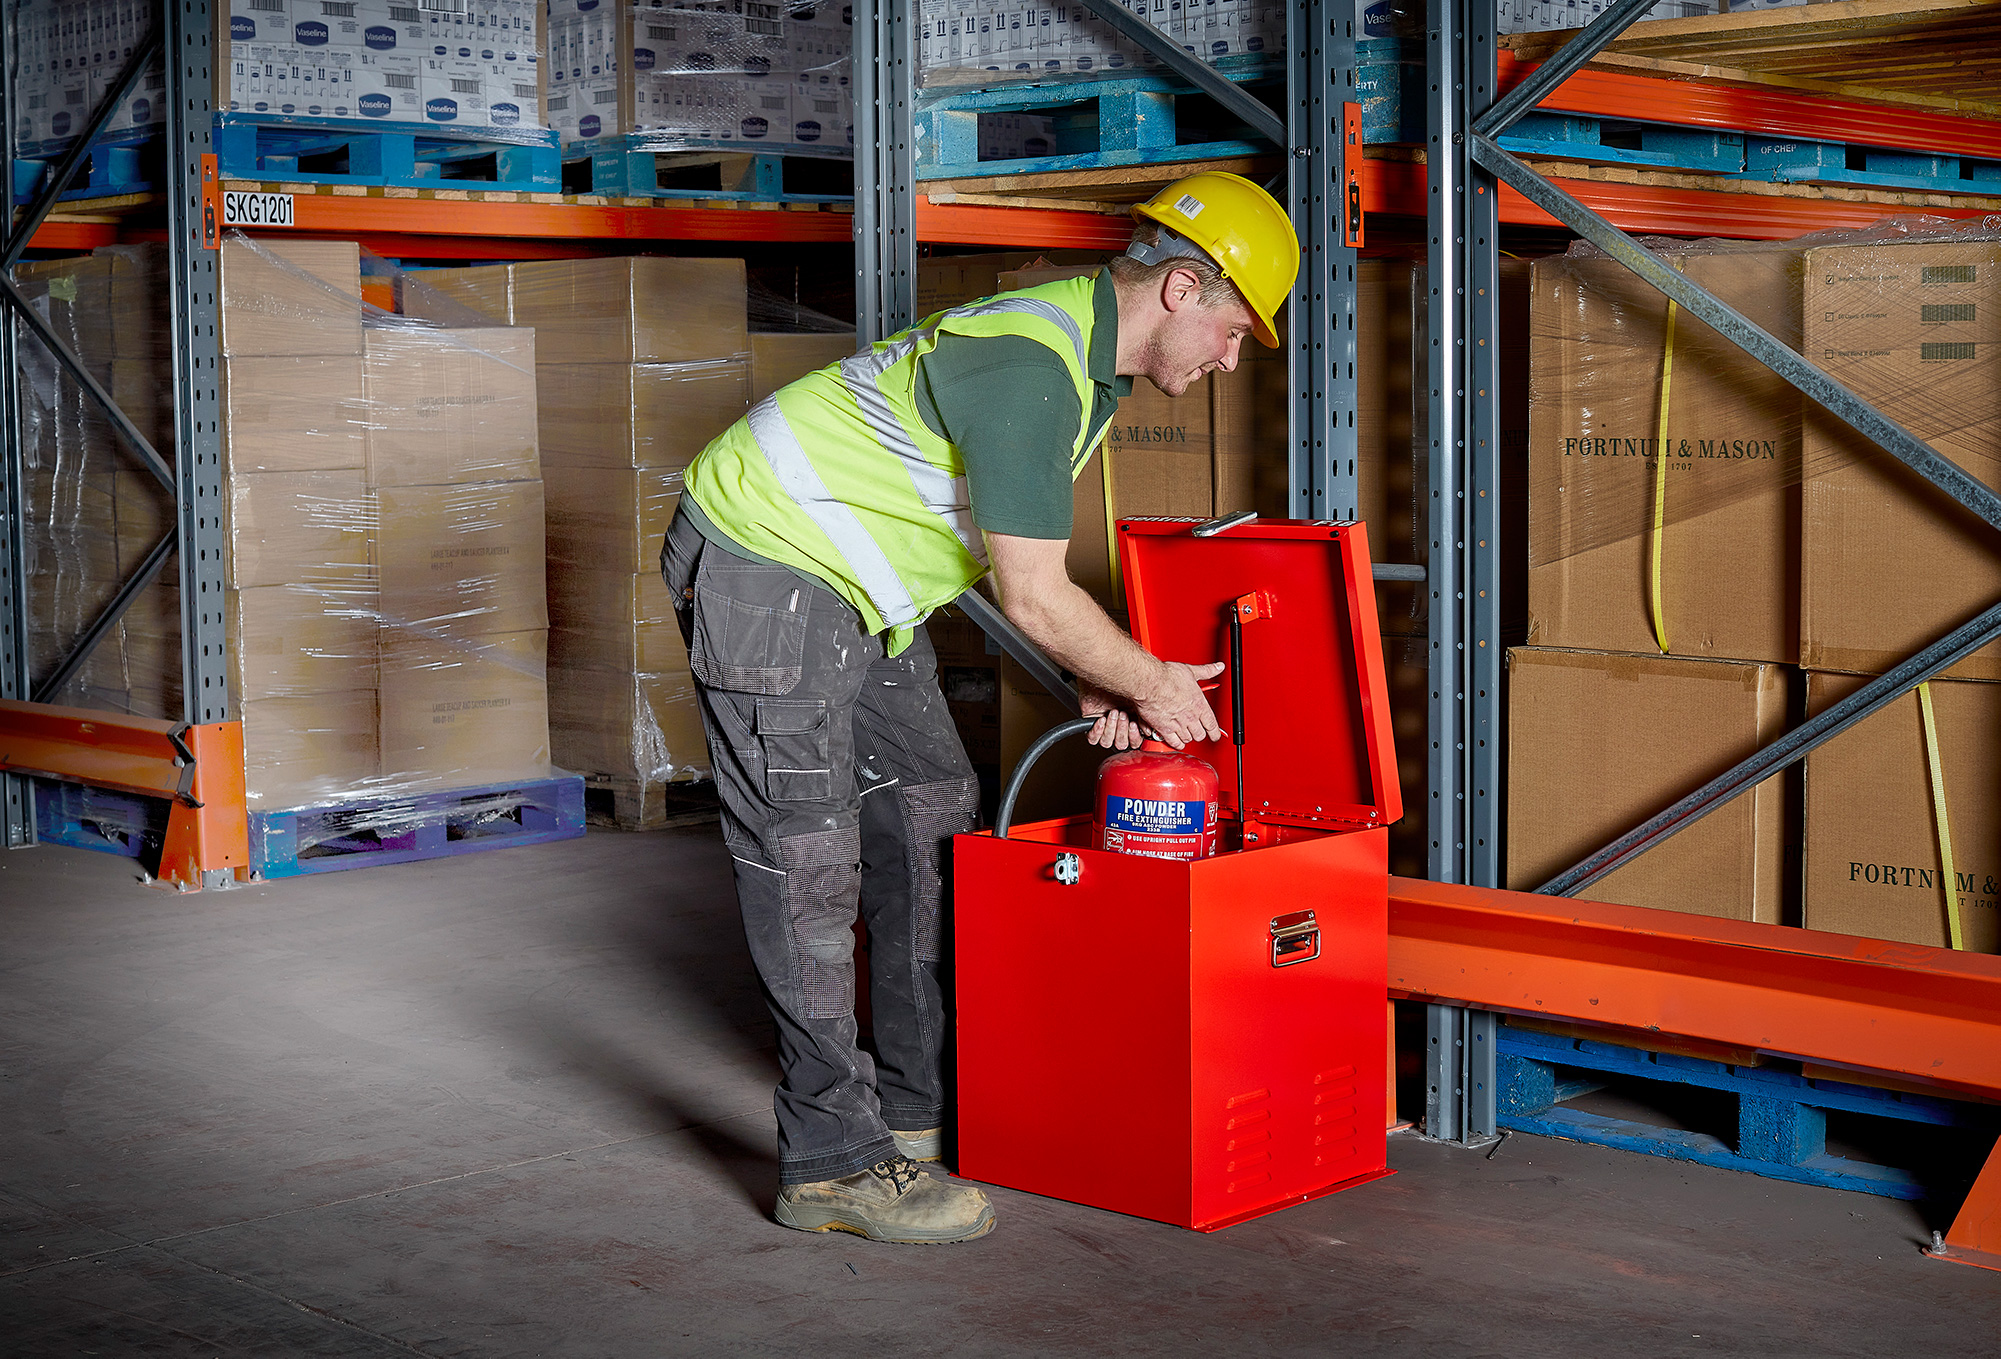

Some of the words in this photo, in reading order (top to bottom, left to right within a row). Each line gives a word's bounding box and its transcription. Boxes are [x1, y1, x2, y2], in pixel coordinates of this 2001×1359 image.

[296, 27, 327, 38] Vaseline
[365, 32, 395, 43] Vaseline
[359, 99, 390, 109] Vaseline
[427, 104, 457, 114] Vaseline
[1761, 146, 1774, 154] OF
[1774, 144, 1797, 153] CHEP
[226, 192, 293, 225] SKG1201
[1111, 425, 1123, 442] &
[1127, 425, 1187, 443] MASON
[1678, 438, 1693, 458] &
[1698, 439, 1777, 460] MASON
[1671, 462, 1692, 471] 1707
[1124, 798, 1186, 818] POWDER
[1117, 812, 1134, 822] FIRE
[1135, 815, 1192, 825] EXTINGUISHER
[1983, 875, 1999, 896] &
